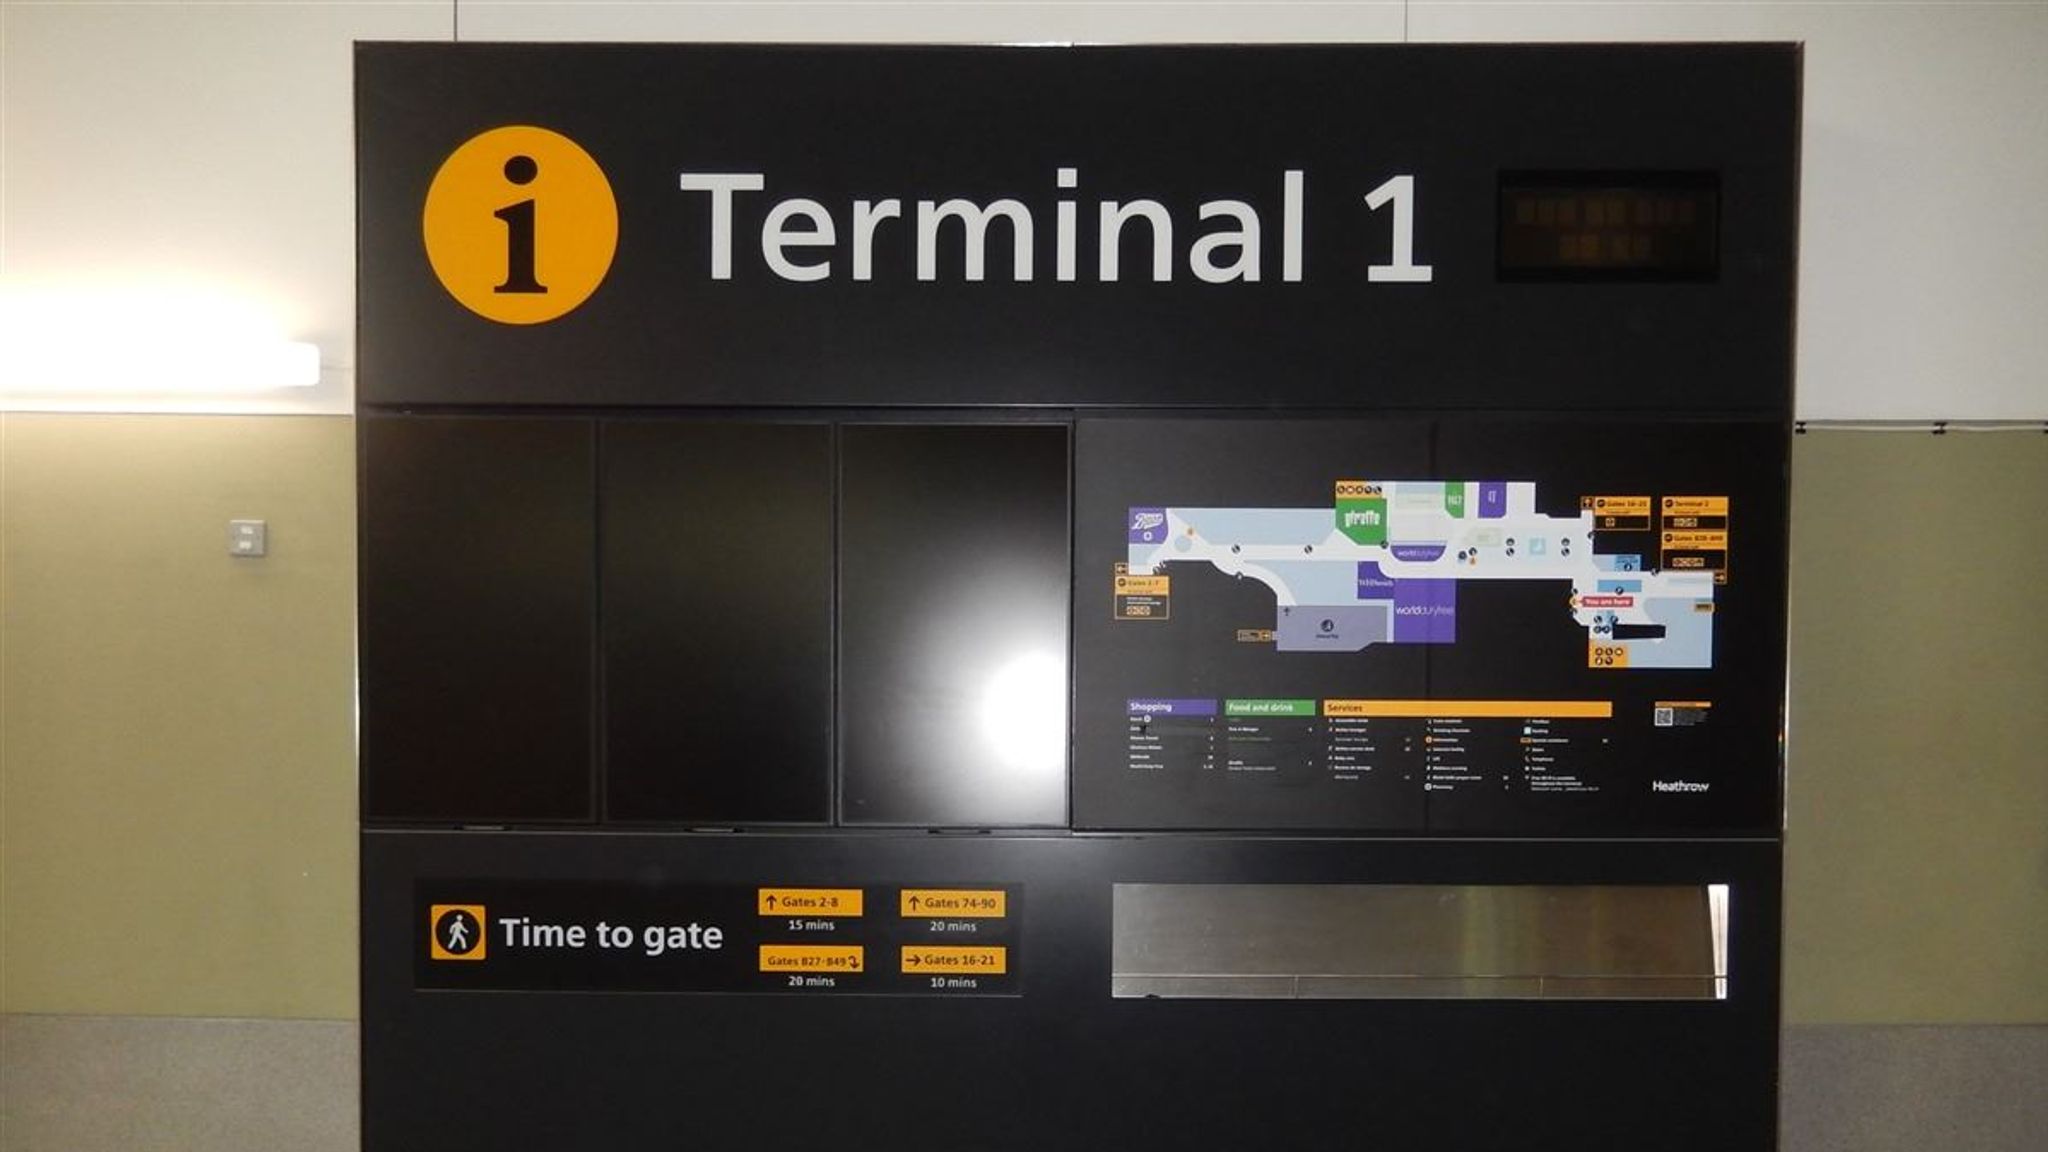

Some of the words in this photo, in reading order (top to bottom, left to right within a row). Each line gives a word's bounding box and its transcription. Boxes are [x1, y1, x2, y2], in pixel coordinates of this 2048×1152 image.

[680, 167, 1304, 284] Terminal
[1364, 175, 1433, 282] 1
[1585, 598, 1599, 606] You
[1614, 598, 1631, 606] here
[1129, 702, 1172, 713] Shopping
[1228, 702, 1250, 712] Food
[1252, 702, 1269, 712] and
[1270, 702, 1293, 712] drink
[1328, 703, 1363, 713] Services
[1652, 780, 1710, 792] Heathrow
[782, 896, 816, 908] Gates
[818, 896, 839, 908] 2-8
[925, 897, 960, 909] Gates
[962, 897, 996, 909] 74-90
[789, 920, 803, 930] 15
[805, 919, 835, 931] mins
[930, 921, 945, 931] 20
[947, 921, 977, 932] mins
[499, 917, 586, 948] Time
[596, 921, 634, 948] to
[643, 922, 723, 955] gate
[767, 955, 799, 966] Gates
[924, 954, 959, 965] Gates
[962, 954, 995, 965] 16-21
[788, 976, 803, 986] 20
[805, 976, 835, 986] mins
[930, 977, 945, 988] 10
[947, 977, 977, 988] mins
